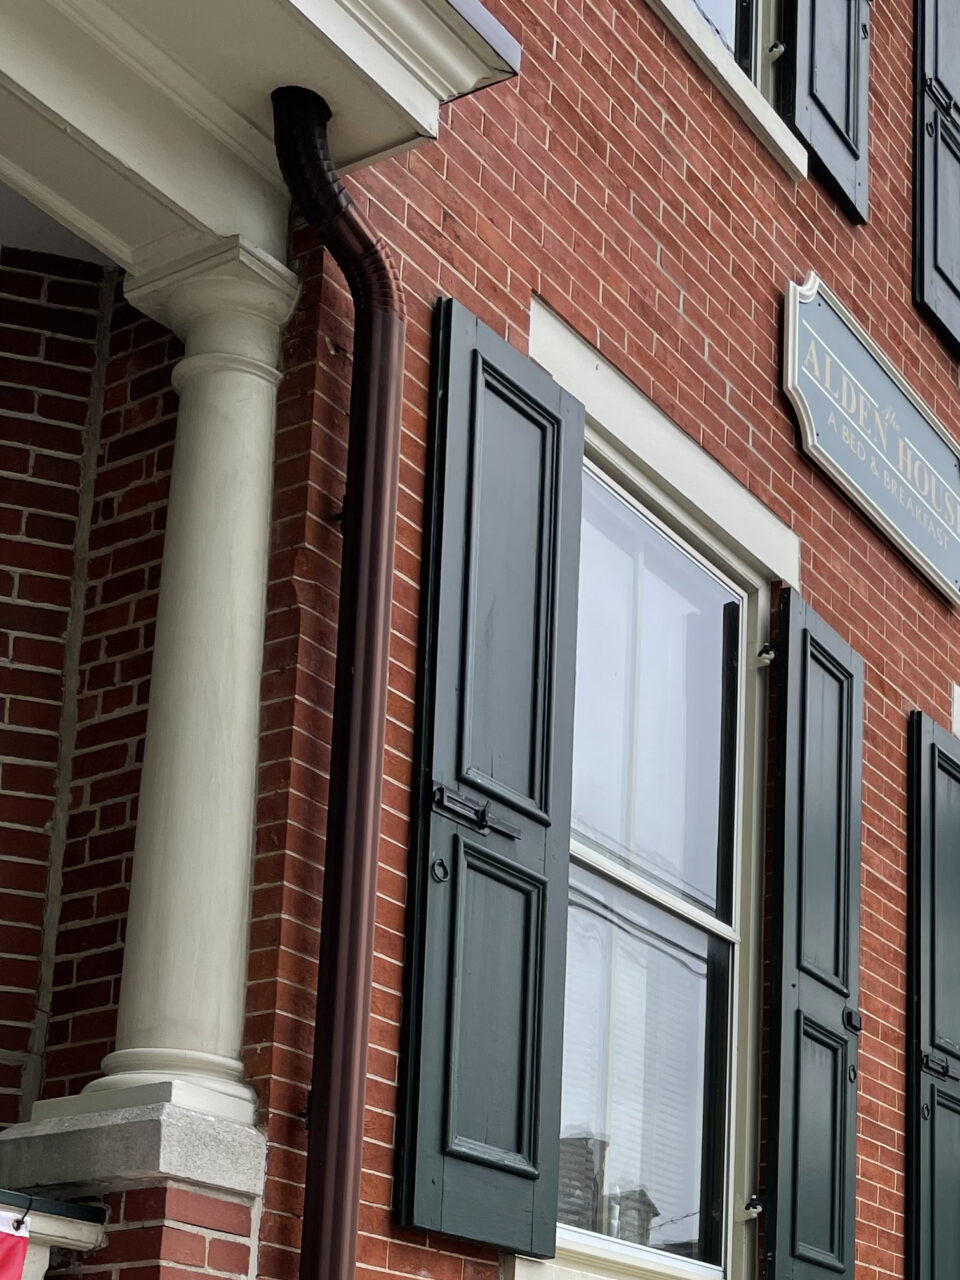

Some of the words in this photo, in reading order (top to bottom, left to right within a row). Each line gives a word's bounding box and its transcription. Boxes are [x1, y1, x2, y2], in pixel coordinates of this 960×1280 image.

[803, 338, 888, 453] ALDEN
[827, 411, 838, 433] A
[842, 423, 867, 461] BED
[870, 456, 881, 478] &
[883, 469, 949, 550] BREAKFAST
